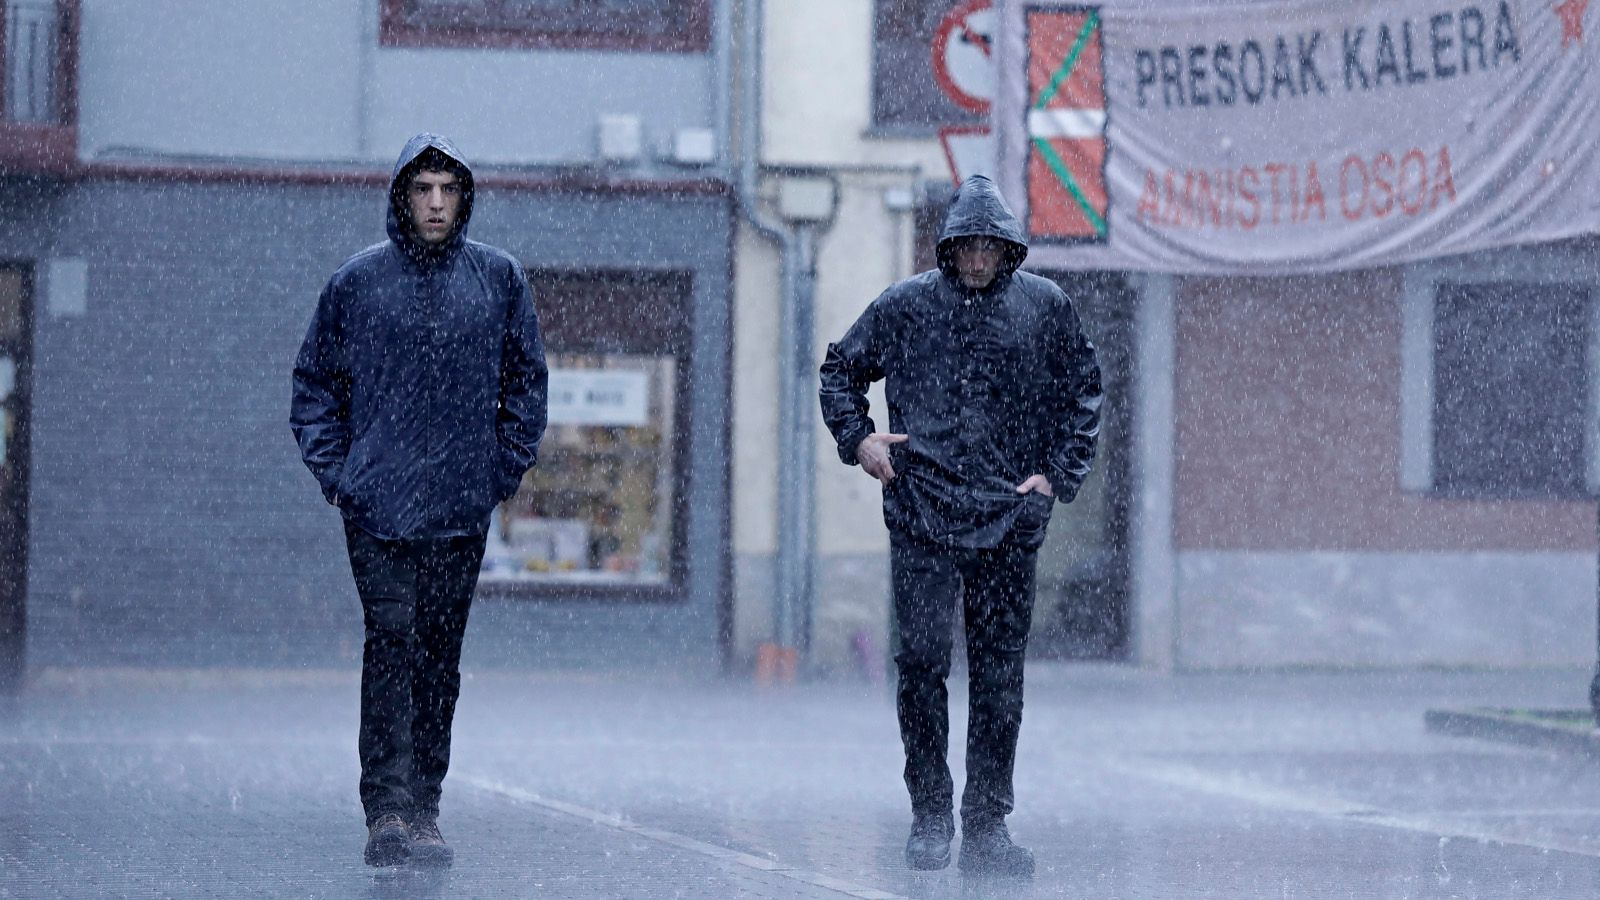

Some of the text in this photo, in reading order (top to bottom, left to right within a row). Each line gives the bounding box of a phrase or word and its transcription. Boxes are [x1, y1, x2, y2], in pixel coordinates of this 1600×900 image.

[1135, 1, 1521, 107] PRESOAK KALERA
[1137, 146, 1457, 230] AMNISTIA OSOA
